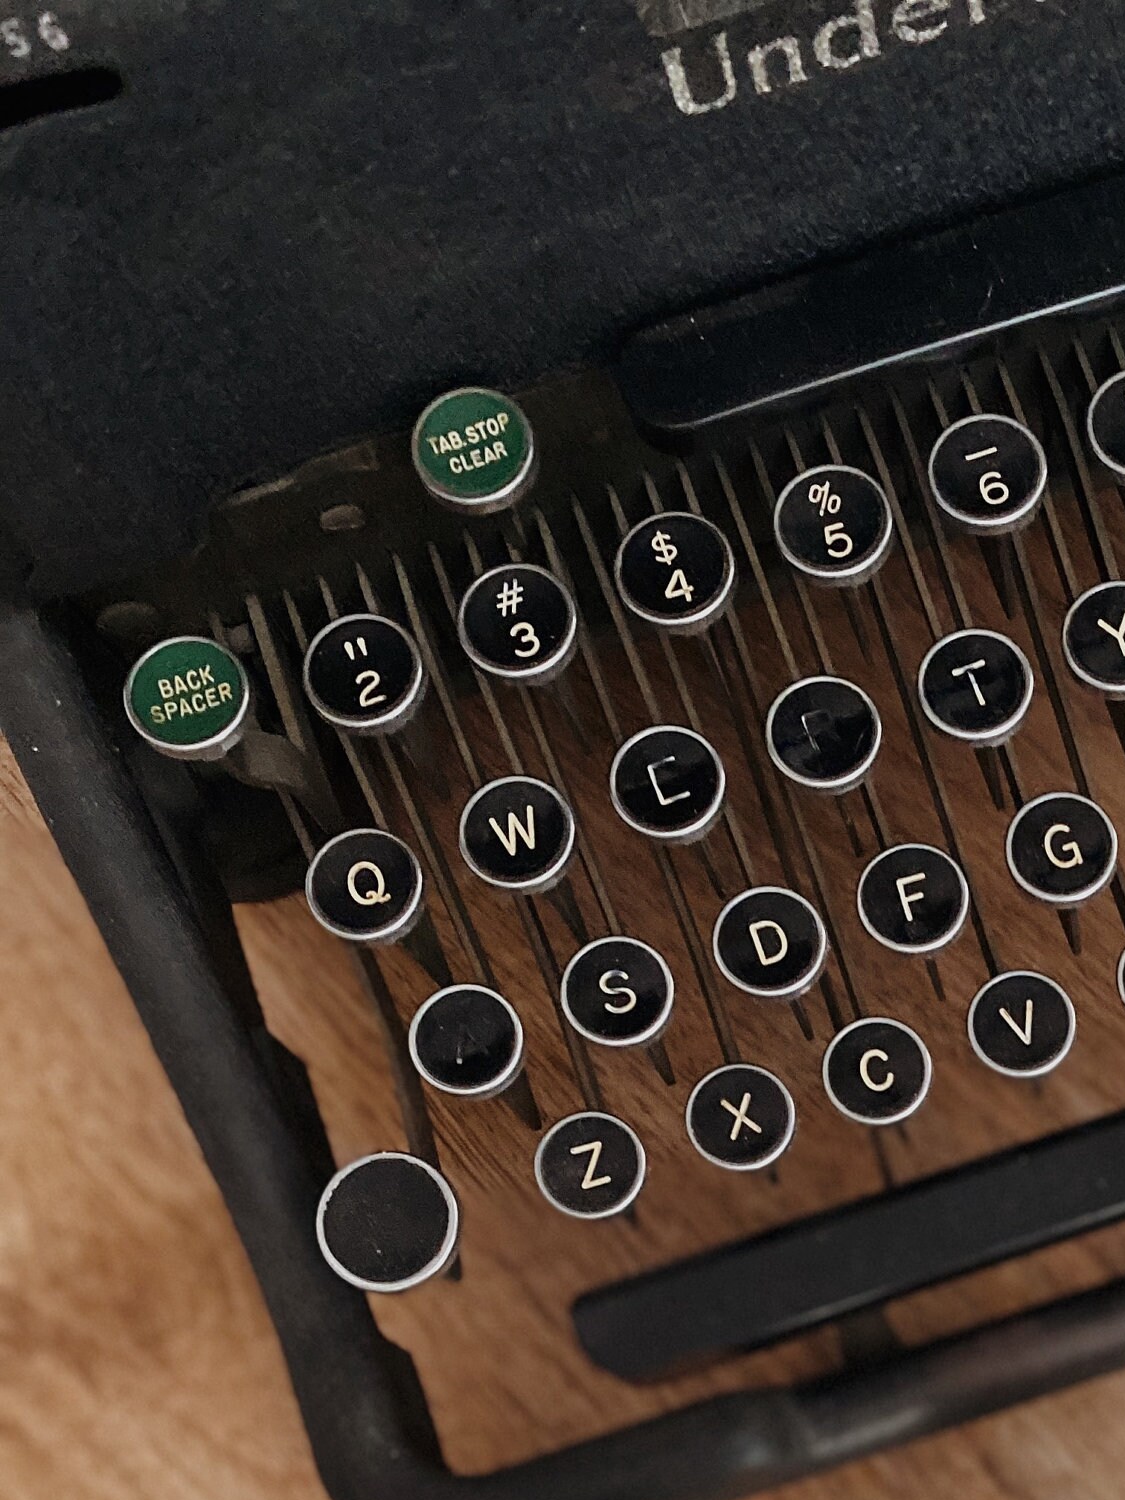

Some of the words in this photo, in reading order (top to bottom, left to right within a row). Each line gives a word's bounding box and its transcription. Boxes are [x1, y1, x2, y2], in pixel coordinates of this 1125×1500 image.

[448, 440, 508, 474] CLEAR
[808, 480, 842, 517] %
[979, 471, 1010, 505] 6
[651, 530, 678, 566] $
[823, 522, 853, 558] 5
[496, 578, 524, 617] #
[664, 568, 694, 602] 4
[509, 621, 541, 658] 3
[149, 682, 234, 725] SPACER
[157, 664, 216, 700] BACK
[355, 670, 386, 707] 2
[951, 659, 986, 706] T
[488, 804, 536, 856] W
[1044, 823, 1084, 869] G
[347, 861, 392, 906] Q
[895, 872, 926, 922] F
[748, 920, 788, 966] D
[598, 970, 637, 1014] S
[998, 999, 1033, 1045] V
[859, 1048, 894, 1092] C
[720, 1092, 762, 1141] X
[570, 1141, 612, 1190] Z
